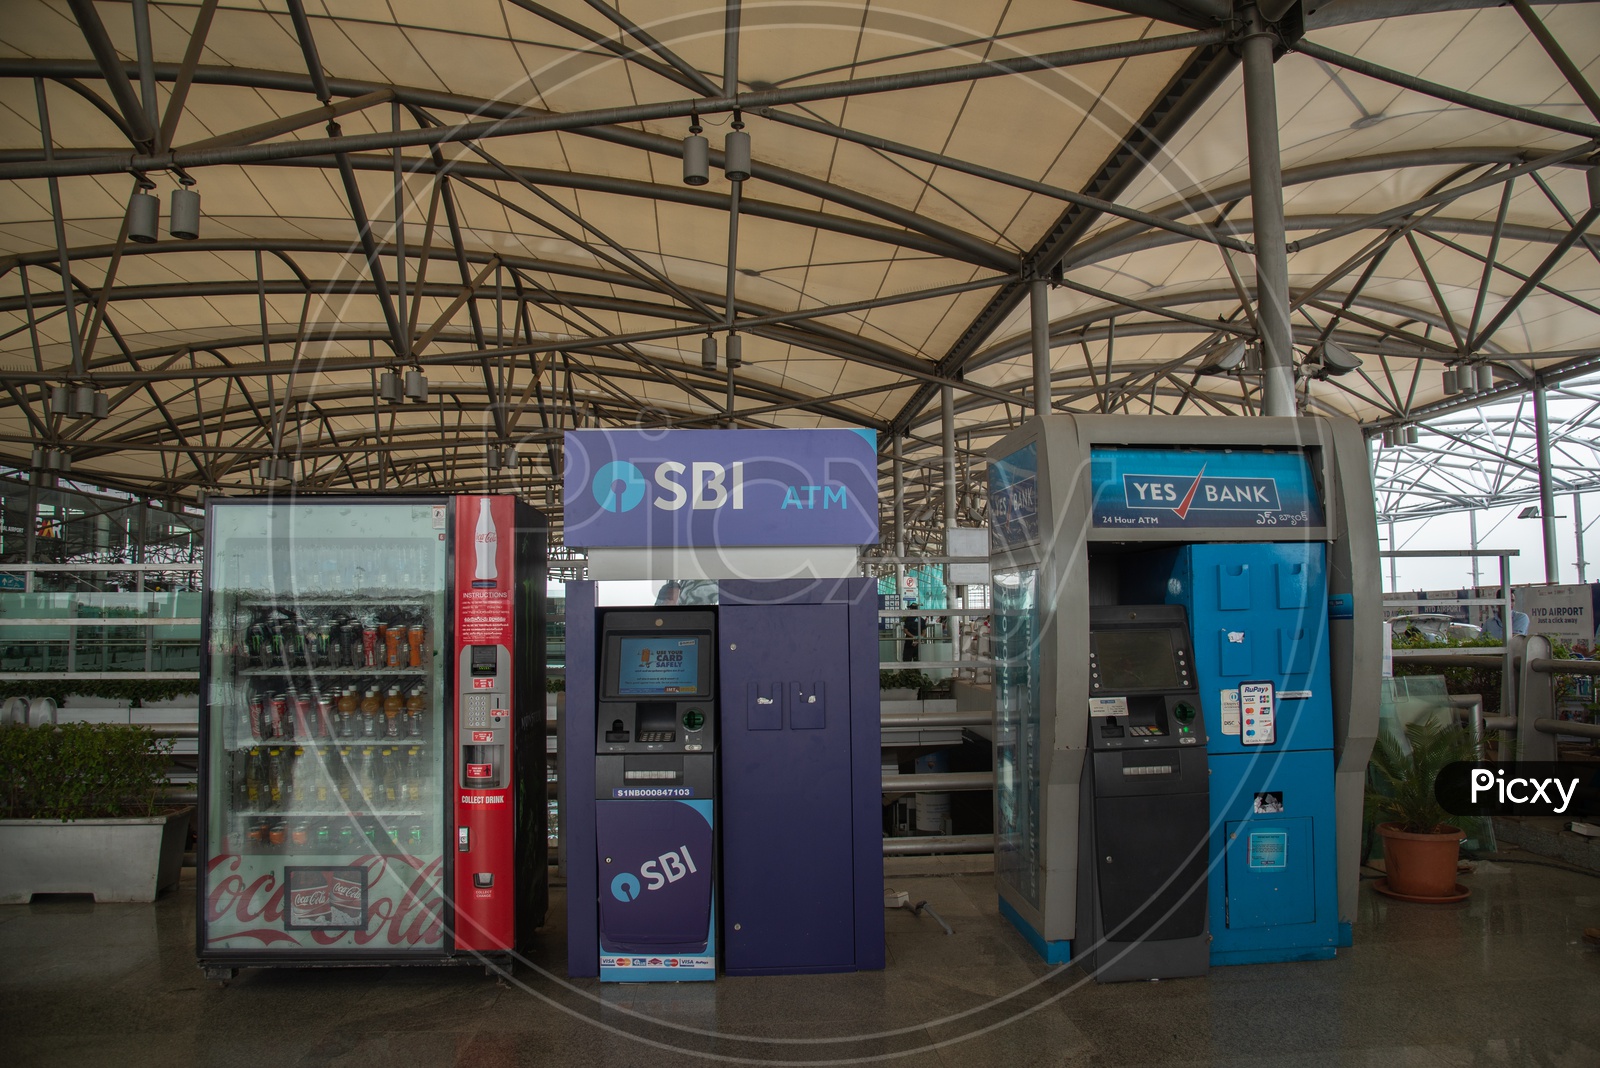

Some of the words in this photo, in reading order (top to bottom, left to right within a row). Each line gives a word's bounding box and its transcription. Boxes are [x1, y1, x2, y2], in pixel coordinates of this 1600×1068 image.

[653, 461, 744, 511] SBI
[781, 486, 848, 510] ATM
[1133, 482, 1177, 501] YES
[1205, 484, 1270, 503] BANK
[1013, 487, 1033, 511] BANK
[1102, 515, 1112, 524] 24
[1114, 516, 1136, 525] Hour
[1137, 516, 1159, 525] ATM
[476, 531, 498, 544] oca-Cola
[1436, 604, 1461, 613] AIRPORT
[1531, 607, 1547, 616] HYD
[1548, 606, 1584, 616] AIRPORT
[656, 654, 683, 662] CARD
[617, 788, 690, 797] S1NB000847103
[461, 795, 485, 804] COLLECT
[485, 794, 505, 804] DRINK
[640, 845, 697, 891] SBI
